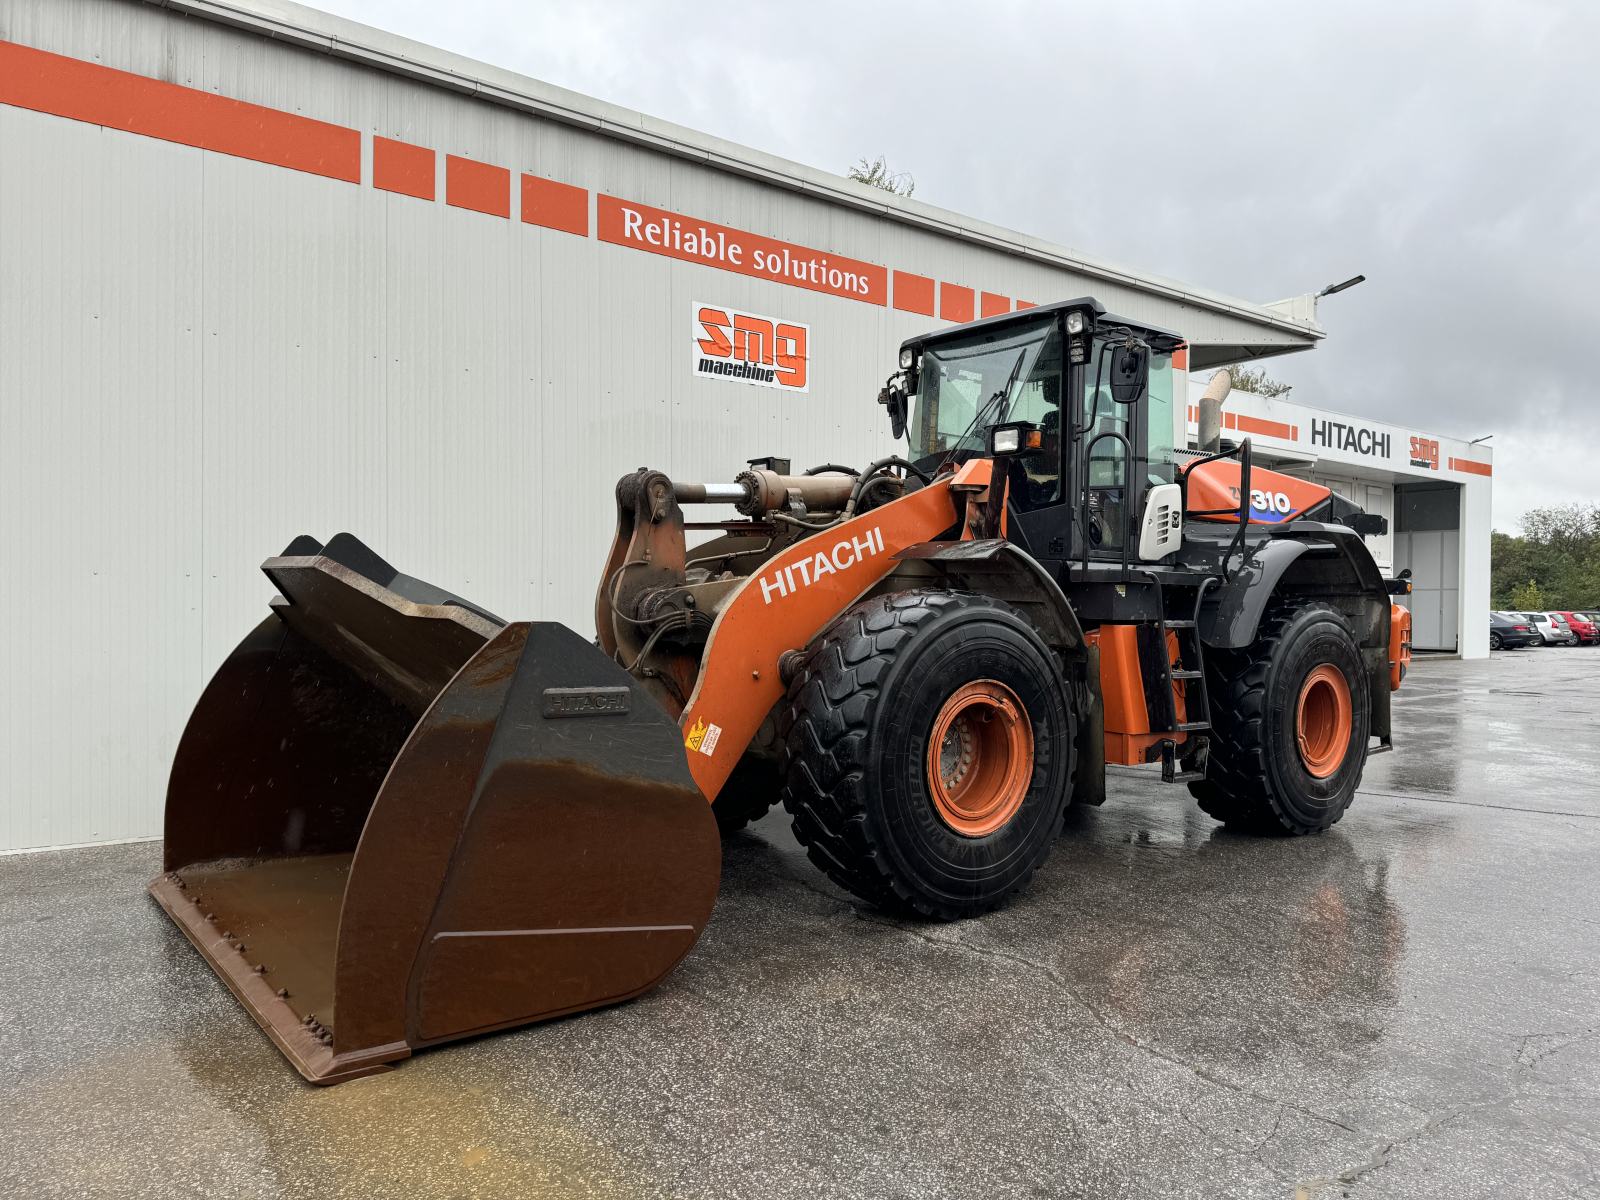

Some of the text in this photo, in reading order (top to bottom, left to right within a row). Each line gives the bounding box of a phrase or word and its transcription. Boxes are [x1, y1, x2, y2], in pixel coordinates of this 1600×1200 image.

[621, 207, 869, 295] Reliable solutions
[697, 307, 807, 388] smg
[698, 358, 775, 383] macchine
[1311, 417, 1391, 459] HITACHI
[1409, 436, 1439, 470] smg
[1249, 488, 1291, 515] 310
[759, 526, 885, 605] HITACHI
[551, 694, 625, 711] HITACHI
